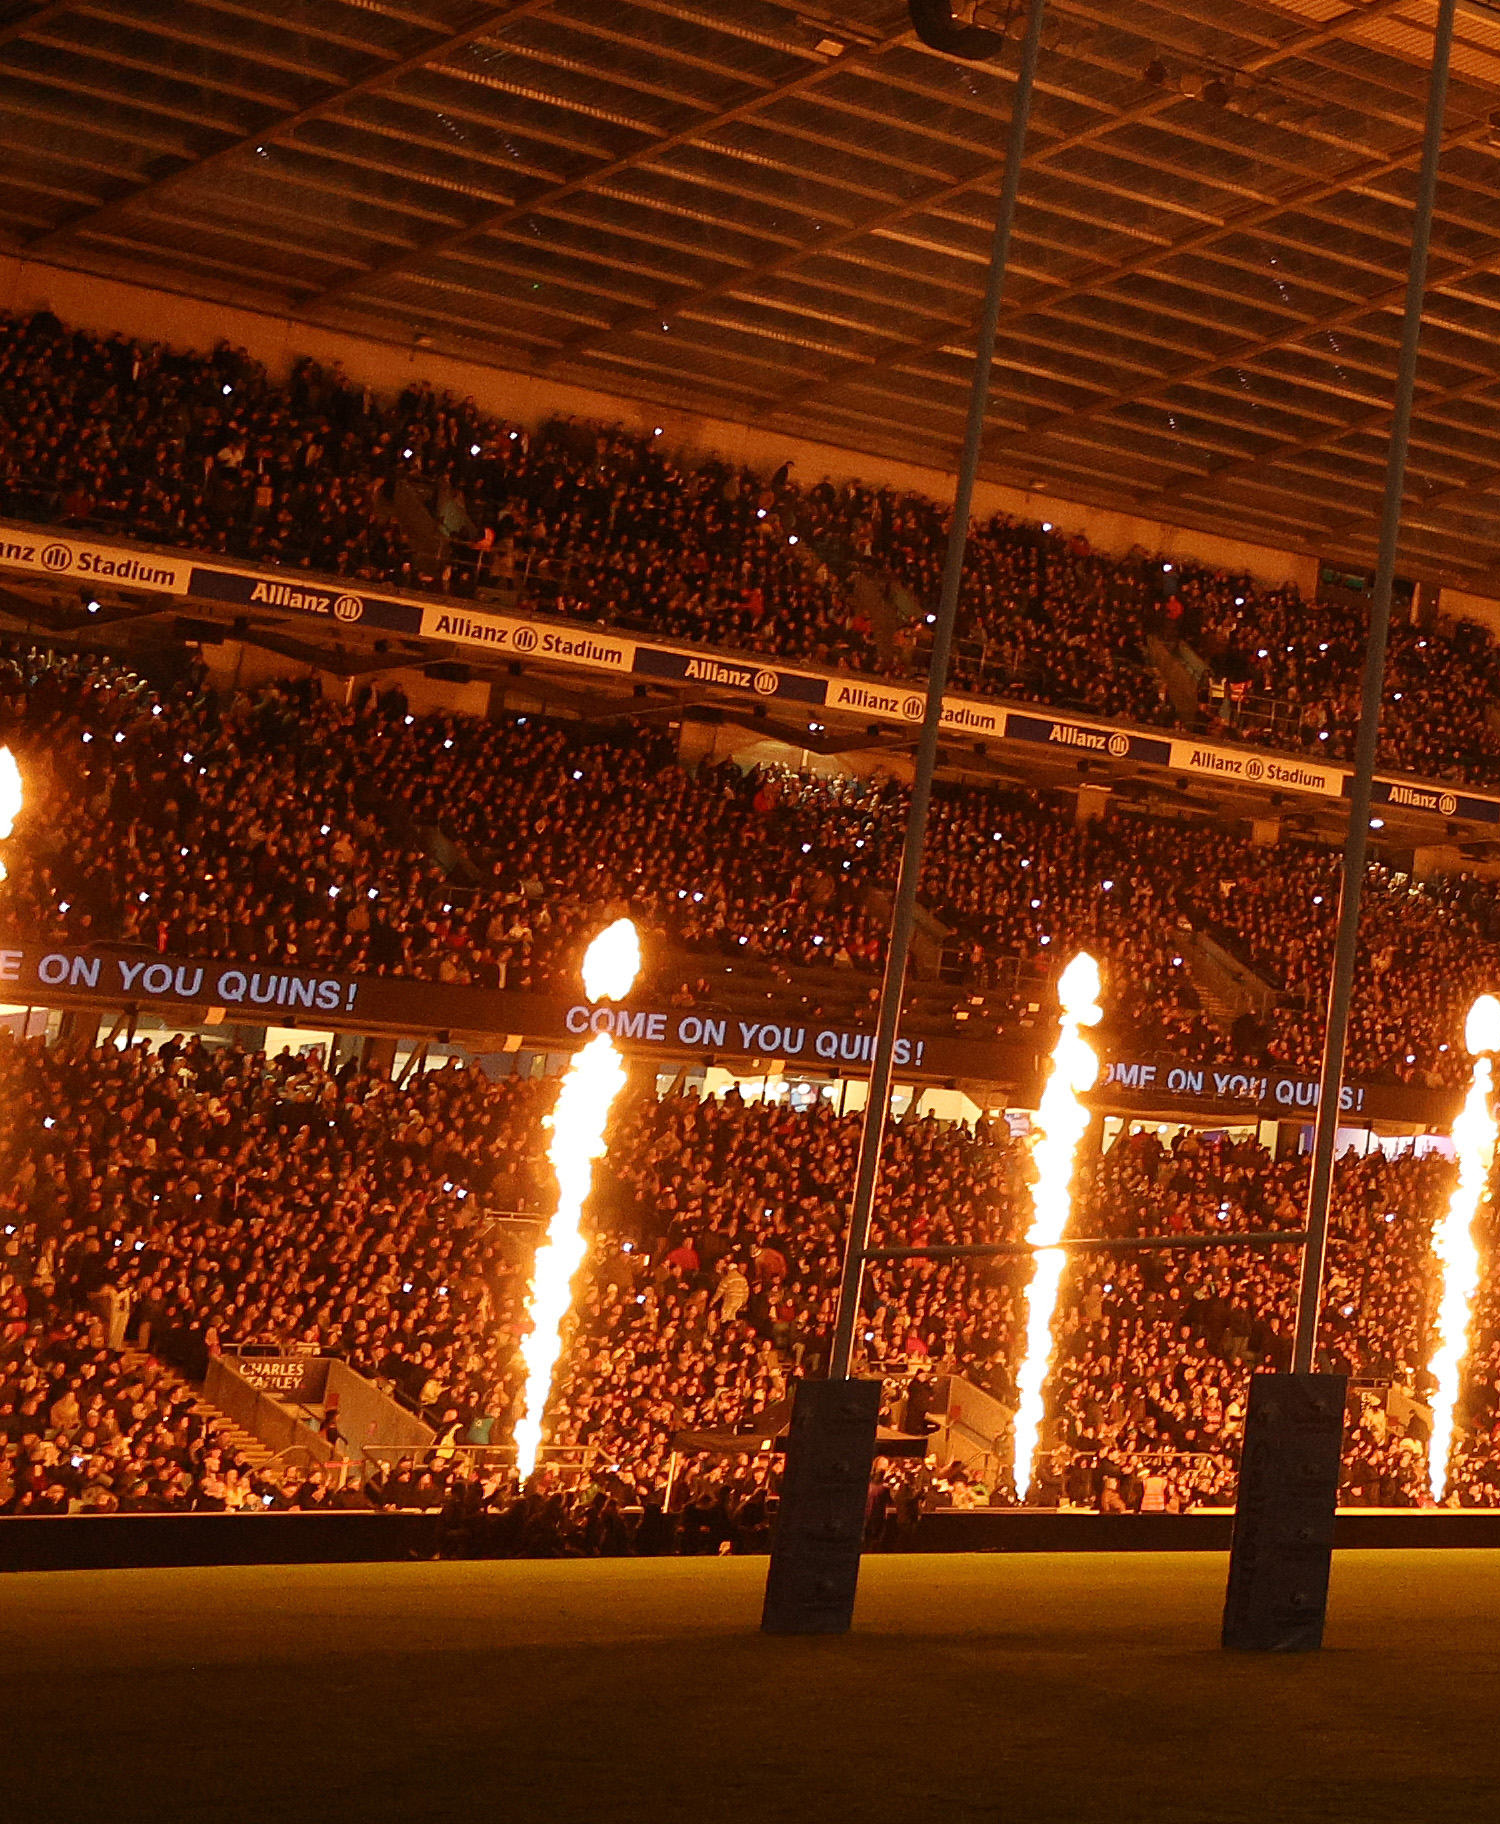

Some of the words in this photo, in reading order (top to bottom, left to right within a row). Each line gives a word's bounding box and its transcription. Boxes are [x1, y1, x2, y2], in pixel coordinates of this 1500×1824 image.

[76, 551, 176, 587] Stadium
[250, 582, 331, 614] Allianz
[435, 615, 508, 643] Allianz
[541, 634, 623, 665] Stadium
[684, 659, 752, 688] Allianz
[837, 687, 899, 713] Allianz
[938, 704, 996, 730] tadium
[1048, 724, 1106, 750] Allianz
[1189, 750, 1242, 774] Allianz
[1267, 764, 1326, 788] Stadium
[1388, 786, 1437, 809] Allianz
[38, 953, 100, 988] ON
[117, 961, 203, 997] YOU
[217, 971, 358, 1011] QUINS!
[565, 1005, 668, 1041] COME
[678, 1016, 727, 1046] ON
[738, 1022, 805, 1053] YOU
[815, 1030, 924, 1066] QUIS!
[1167, 1068, 1203, 1094] ON
[1212, 1072, 1266, 1100] YOU
[1274, 1079, 1365, 1112] QUIS!
[240, 1363, 304, 1375] CHARLES
